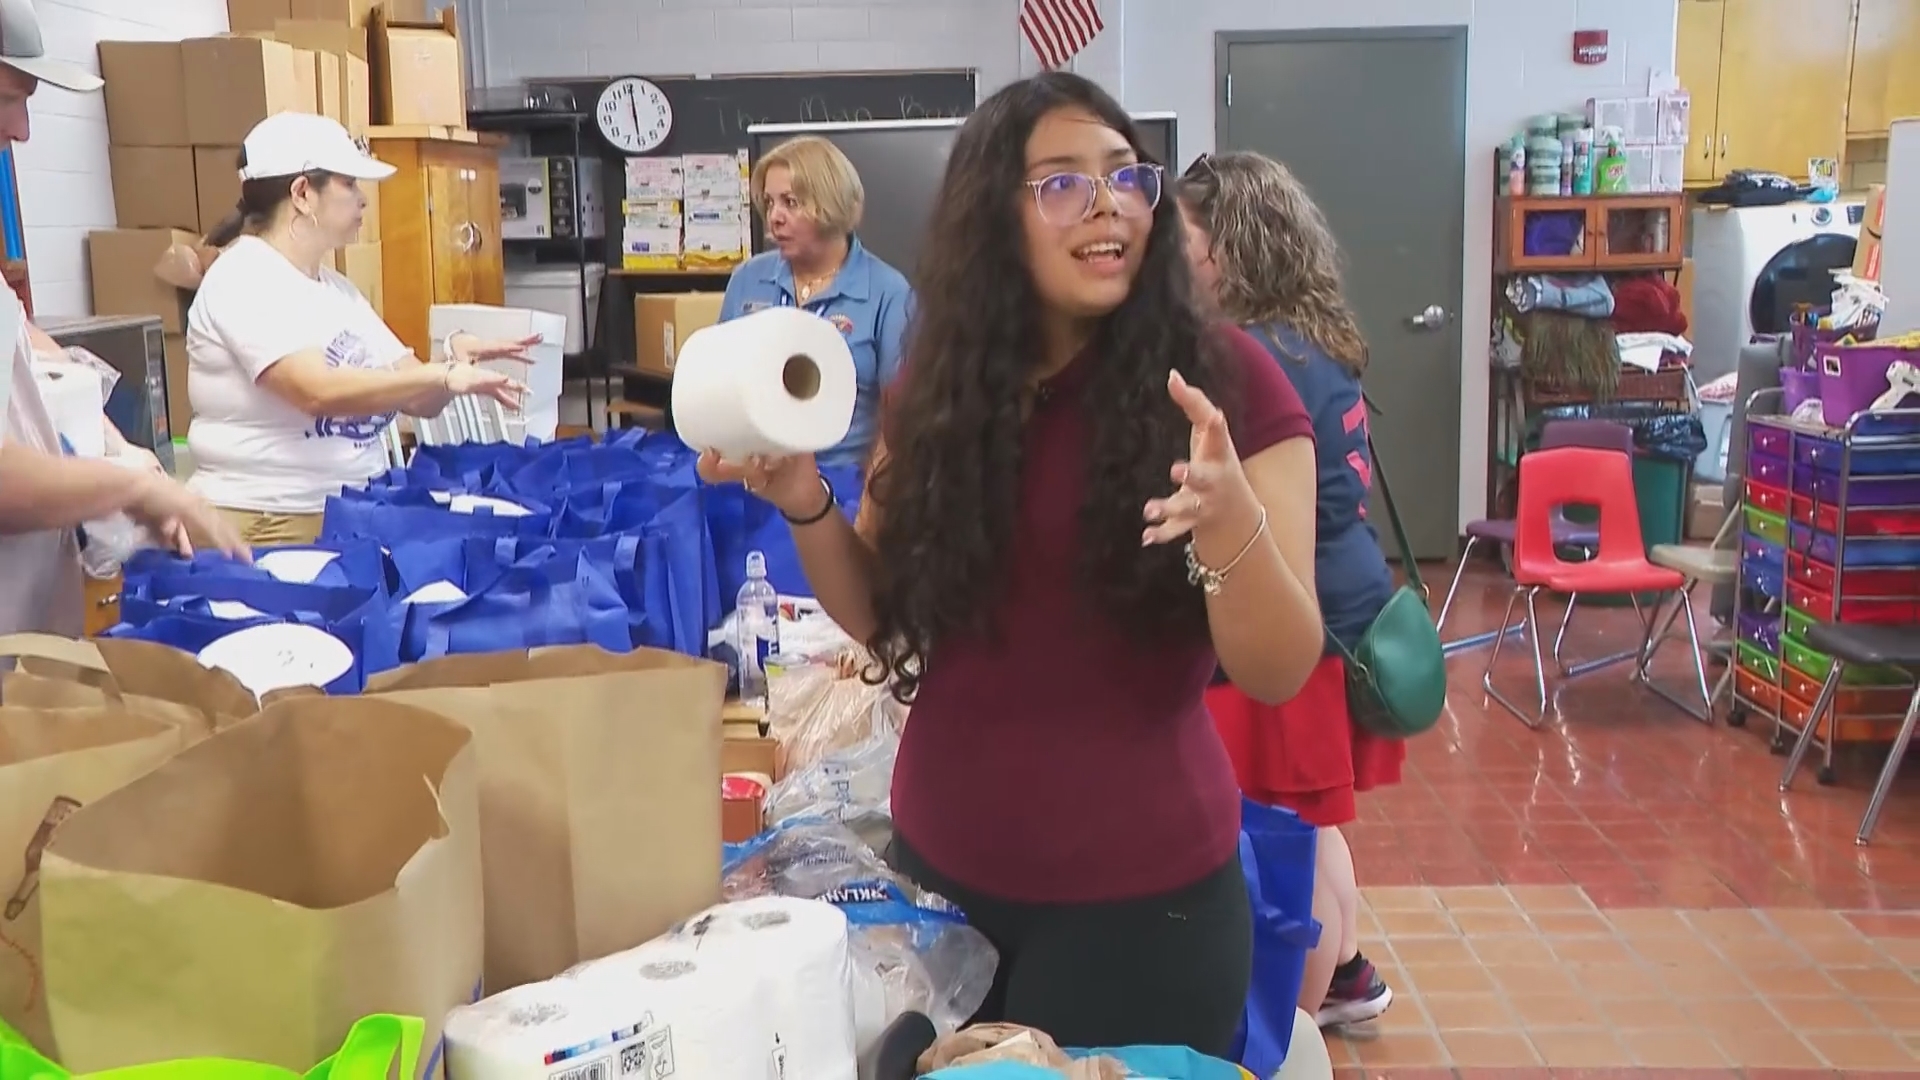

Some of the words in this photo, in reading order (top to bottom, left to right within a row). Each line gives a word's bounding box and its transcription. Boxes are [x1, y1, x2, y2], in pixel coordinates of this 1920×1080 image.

[641, 85, 645, 95] 1
[612, 90, 622, 101] 11
[650, 93, 658, 104] 2
[604, 102, 617, 112] 10
[657, 105, 666, 115] 3
[603, 115, 612, 125] 9
[657, 118, 665, 128] 4
[611, 126, 620, 137] 8
[649, 130, 658, 140] 5
[624, 135, 631, 144] 7
[637, 136, 646, 146] 6
